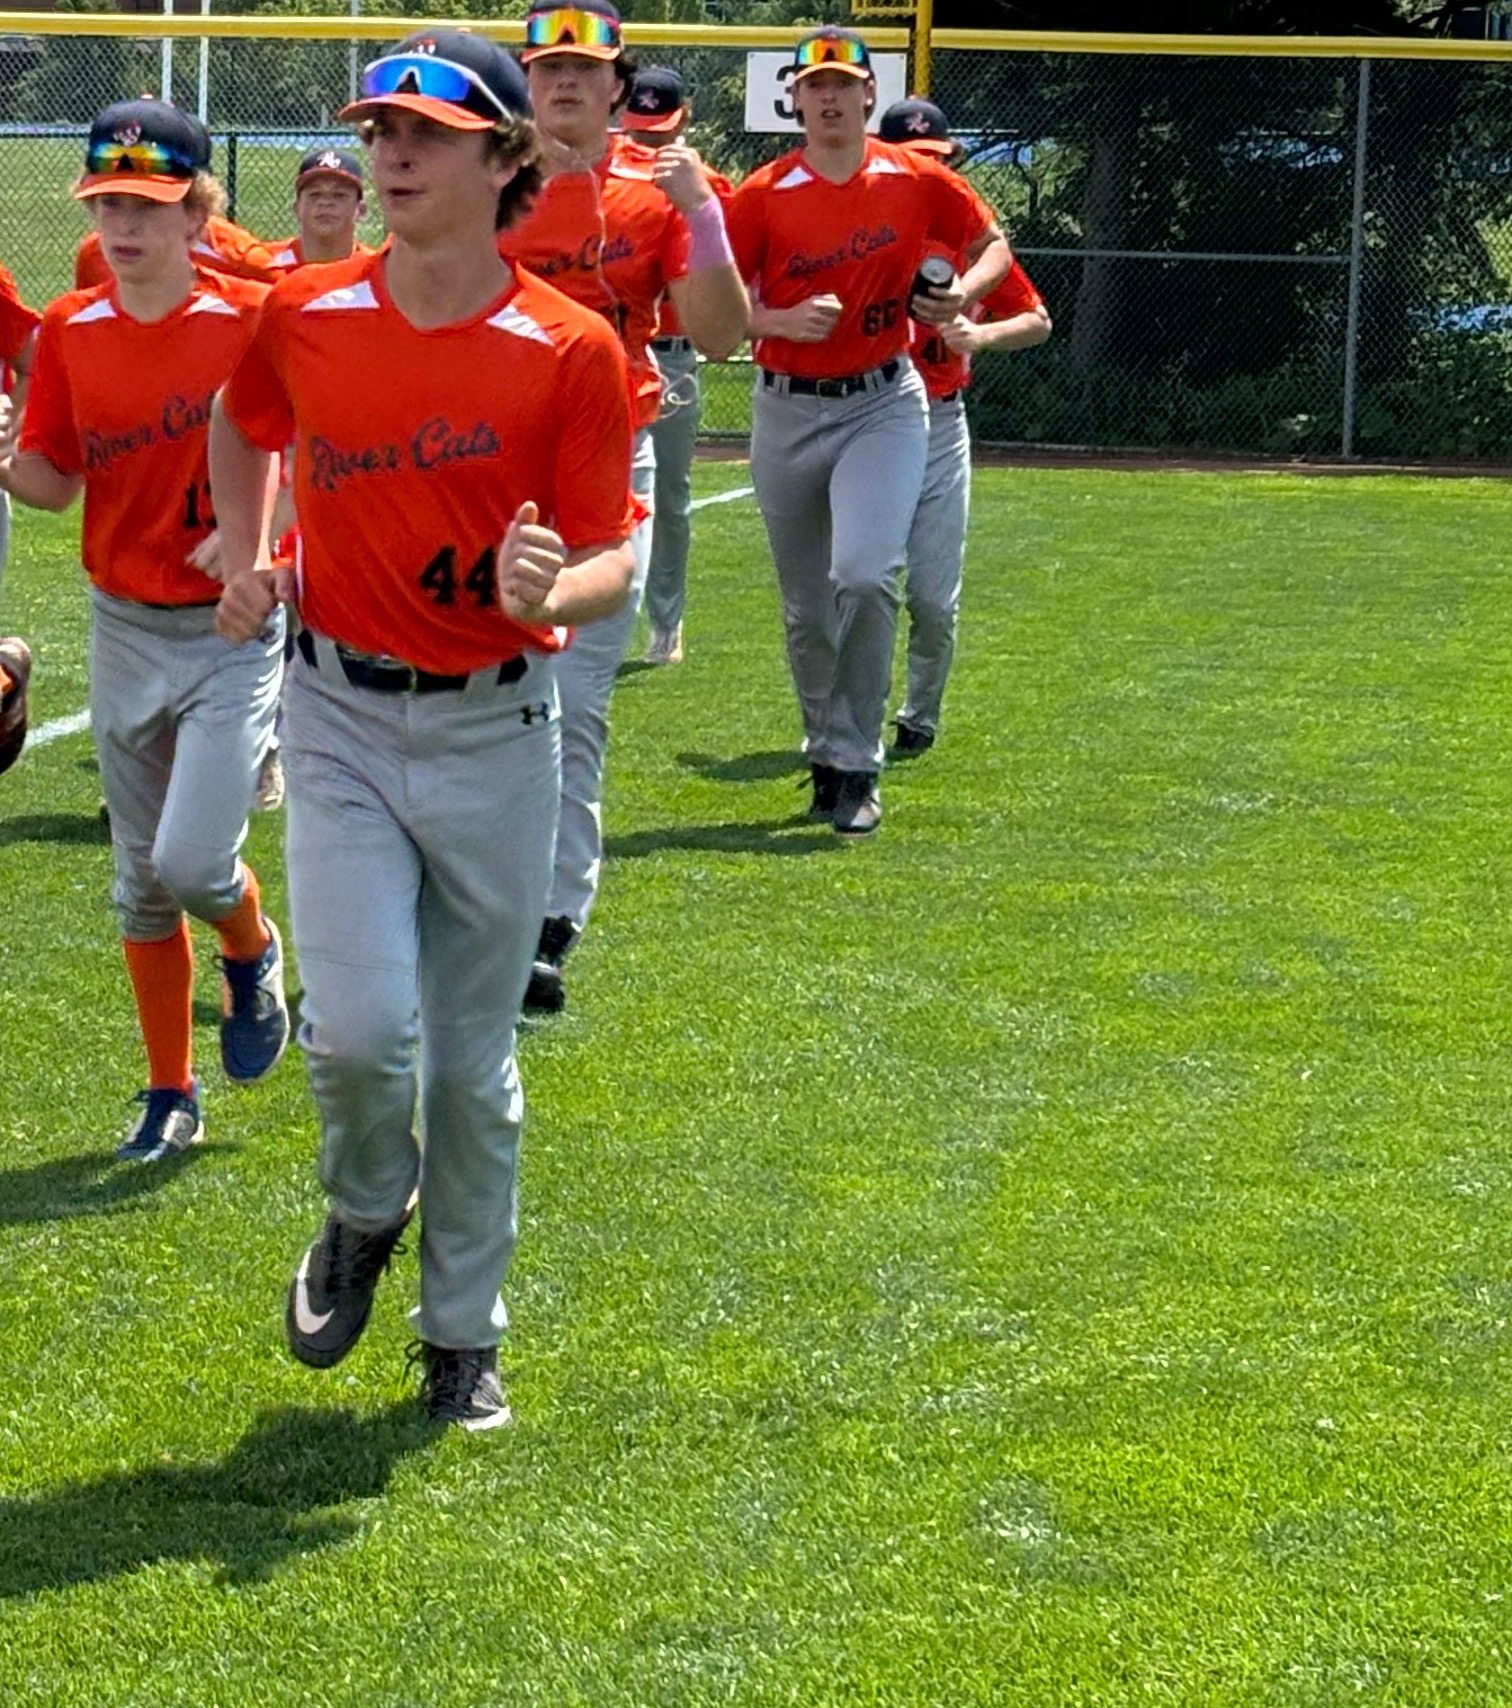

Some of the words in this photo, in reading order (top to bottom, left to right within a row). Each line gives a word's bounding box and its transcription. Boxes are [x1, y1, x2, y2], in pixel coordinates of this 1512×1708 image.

[162, 389, 216, 439] Cat
[310, 436, 400, 491] River
[412, 417, 500, 468] Cats
[420, 545, 499, 608] 44
